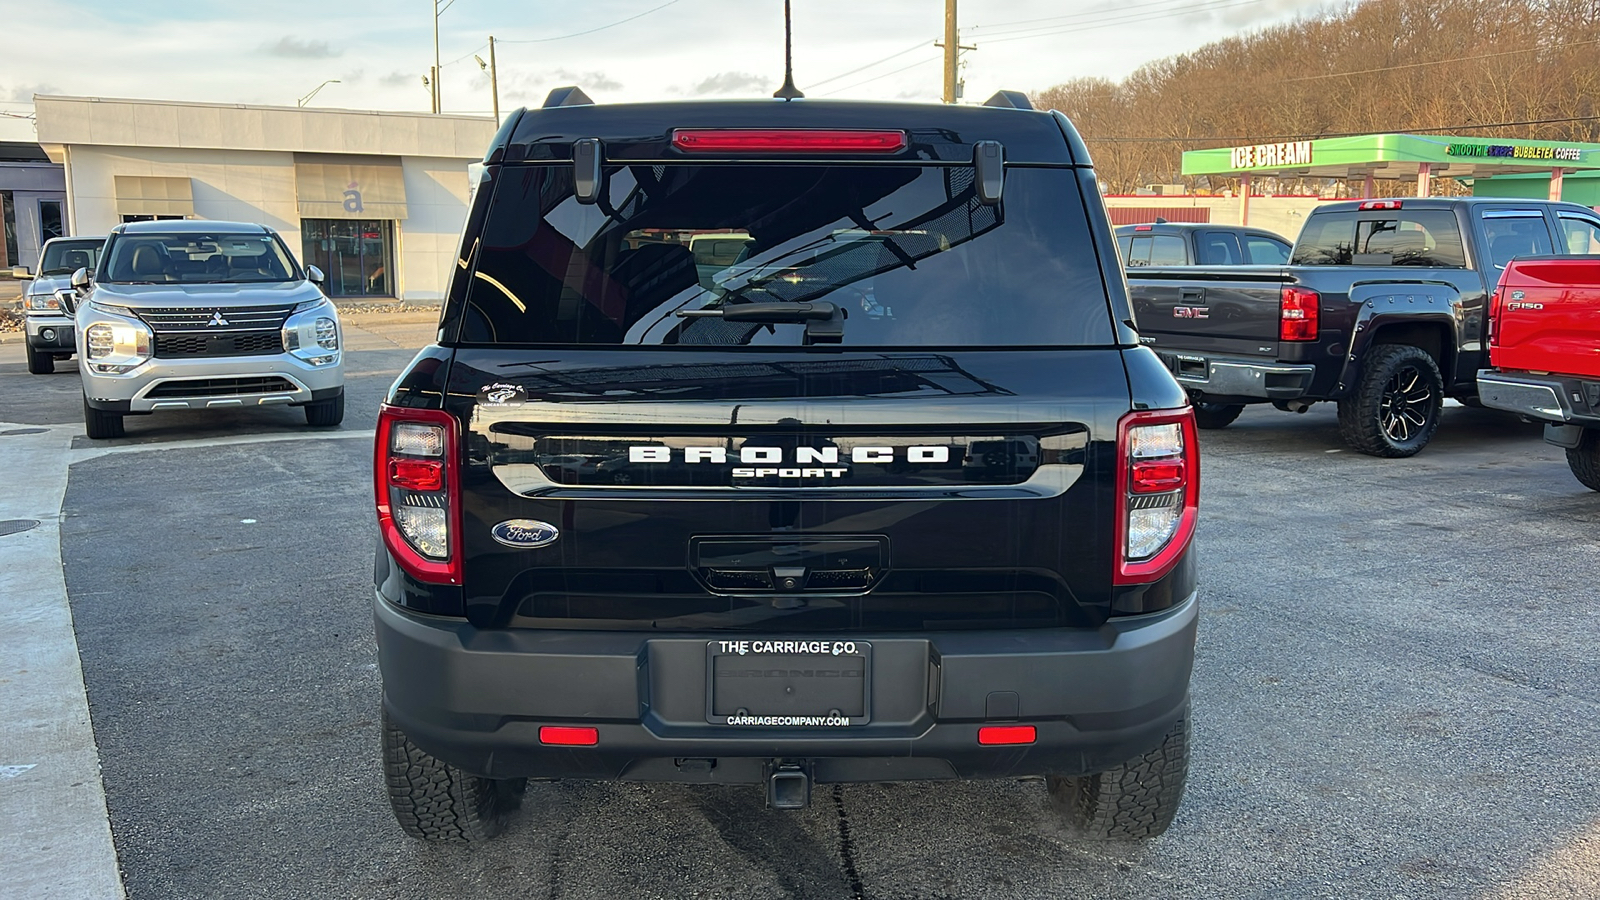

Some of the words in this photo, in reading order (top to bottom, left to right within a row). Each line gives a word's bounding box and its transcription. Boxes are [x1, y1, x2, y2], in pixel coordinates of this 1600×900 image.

[1231, 146, 1255, 169] ICE
[1257, 142, 1313, 167] CREAM
[1449, 143, 1488, 156] SMOOTHIE
[1555, 148, 1581, 160] COFFEE
[1173, 306, 1209, 318] GMC
[628, 446, 950, 464] BRONCO
[731, 467, 848, 478] SPORT
[506, 524, 543, 541] Ford
[719, 640, 750, 653] THE
[752, 640, 830, 654] CARRIAGE
[832, 641, 859, 655] CO.
[727, 716, 850, 727] CARRIAGECOMPANY.COM
